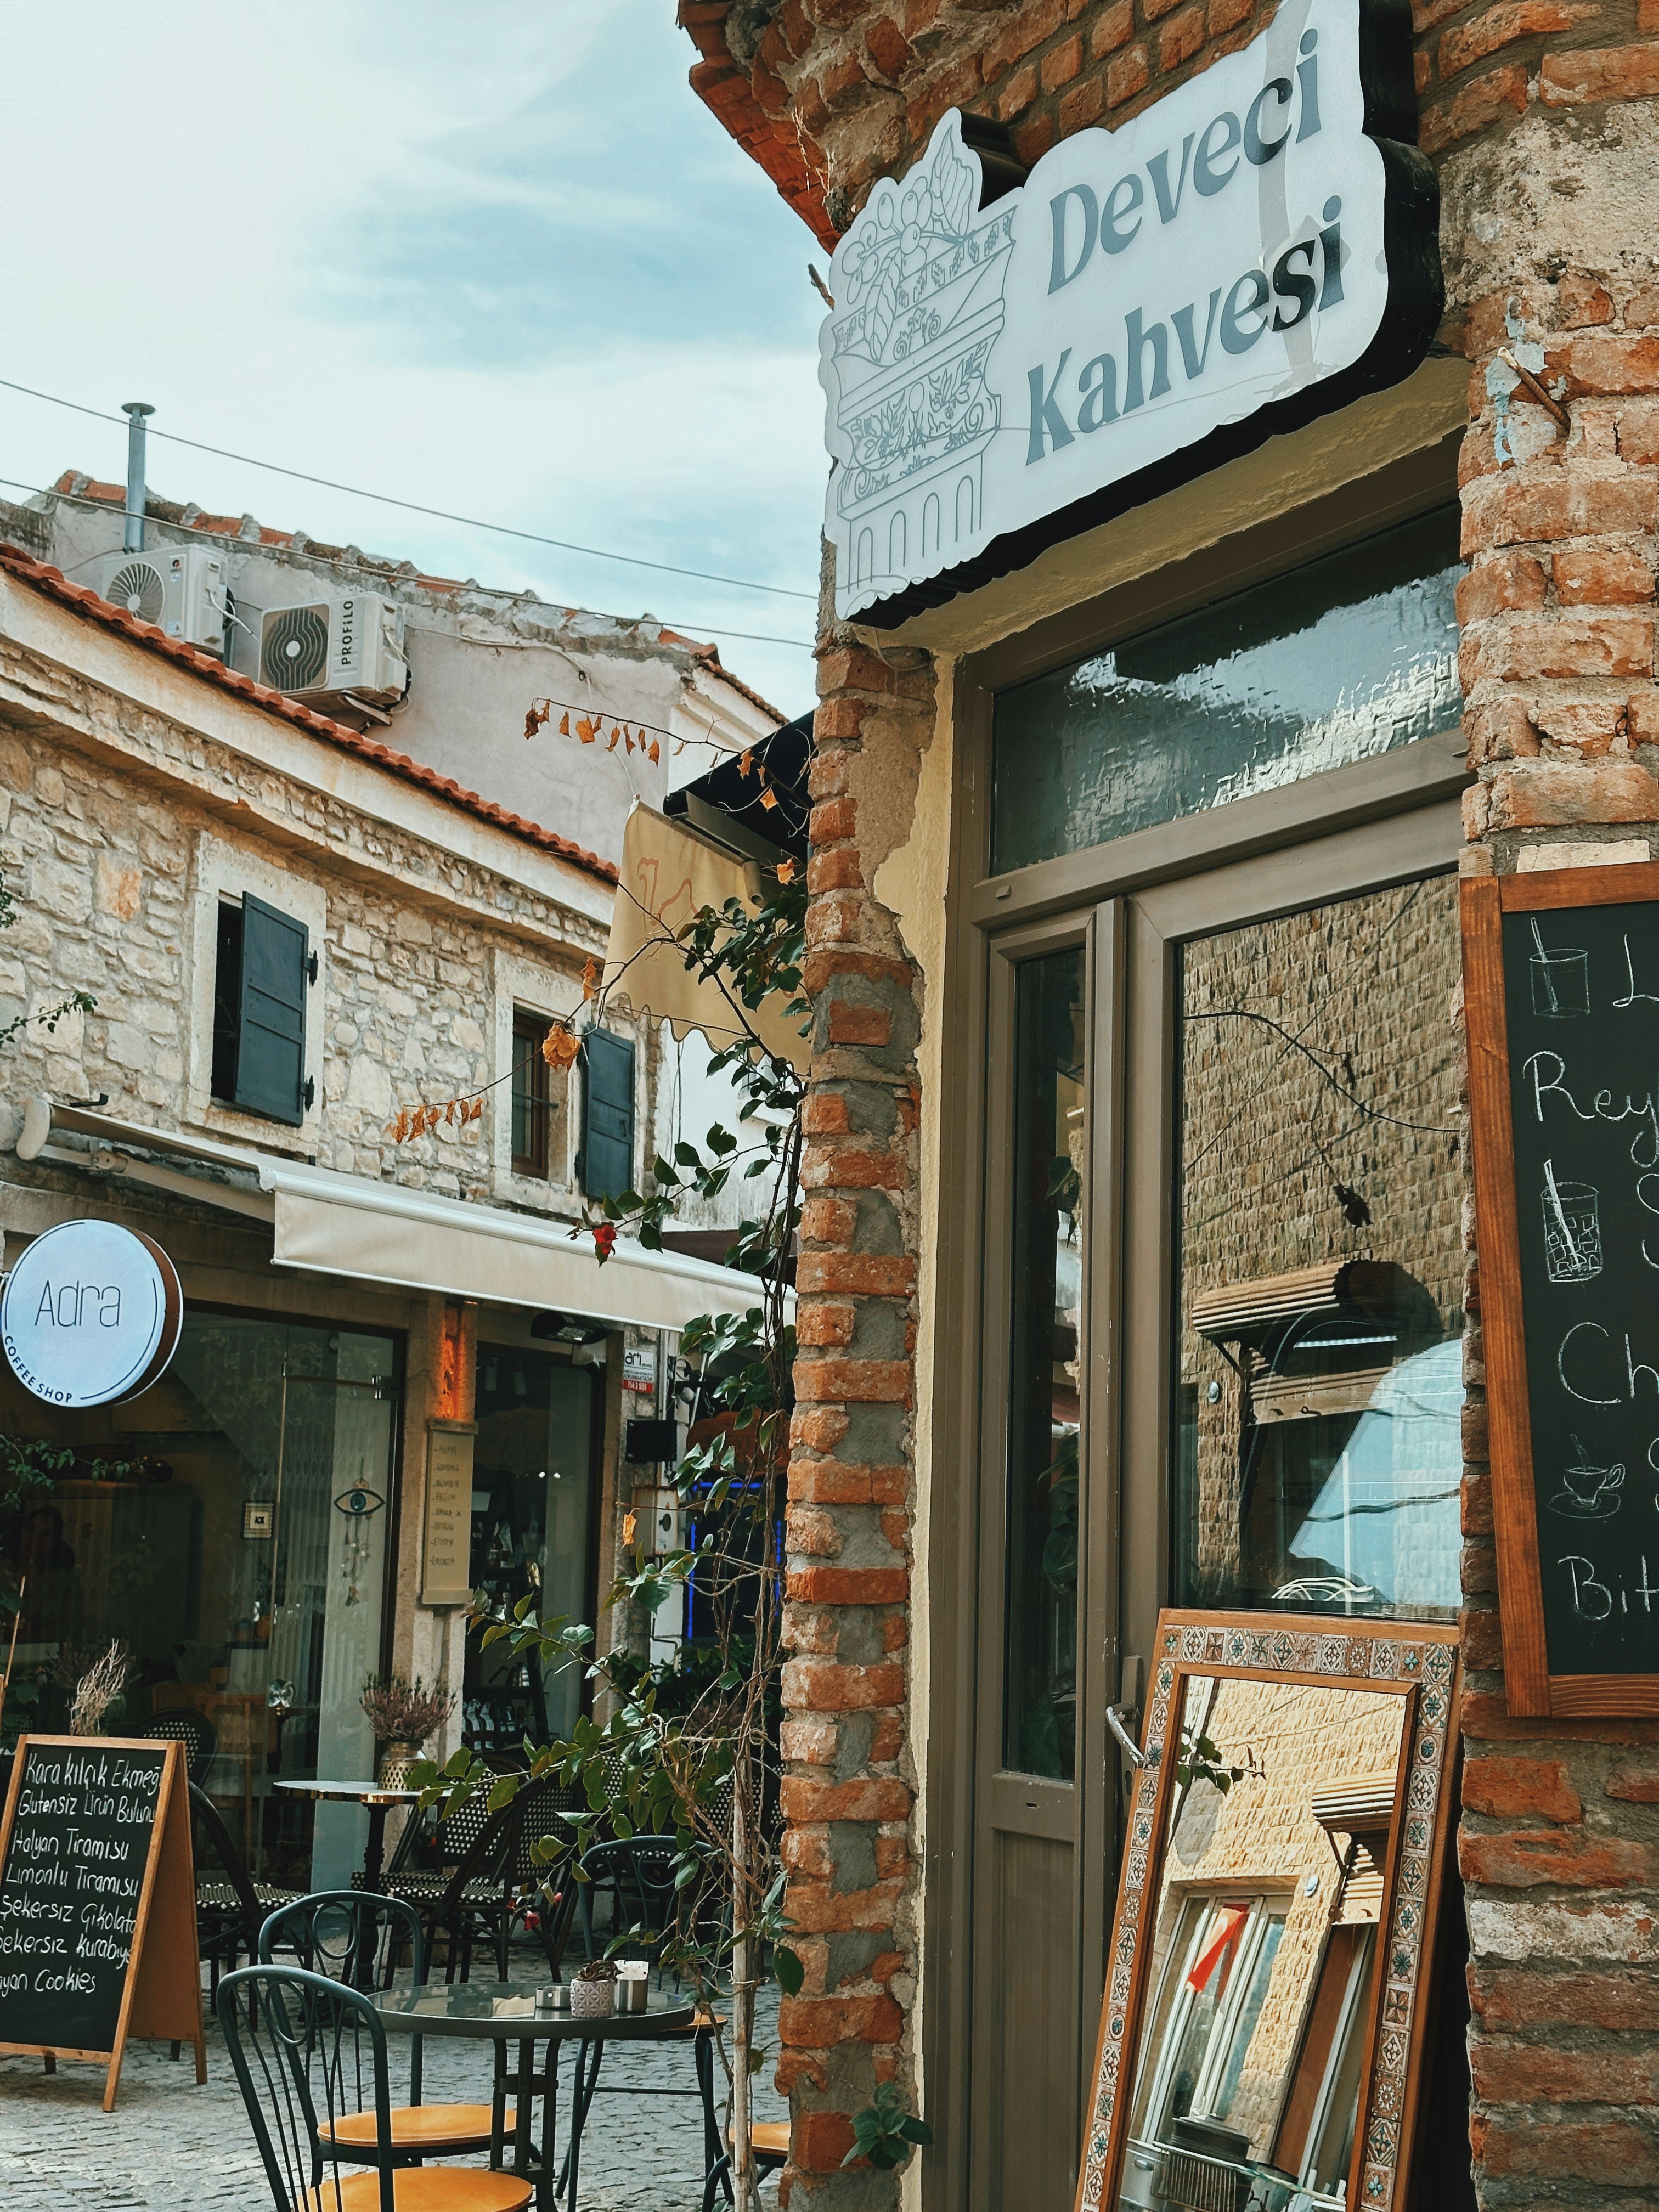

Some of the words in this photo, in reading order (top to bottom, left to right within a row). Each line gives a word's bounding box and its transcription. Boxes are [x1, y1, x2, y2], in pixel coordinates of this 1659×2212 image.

[1047, 28, 1322, 296] Deveci
[1025, 194, 1345, 466] Kahvesi
[1523, 1050, 1659, 1168] Rey
[35, 1280, 121, 1327] Adra
[5, 1335, 36, 1387] COFFEE
[37, 1383, 72, 1403] SHOP
[19, 1789, 77, 1816] Glutensiz
[84, 1790, 114, 1815] Ürün
[66, 1828, 129, 1860] Tiramisu
[35, 1965, 95, 1994] Cookies
